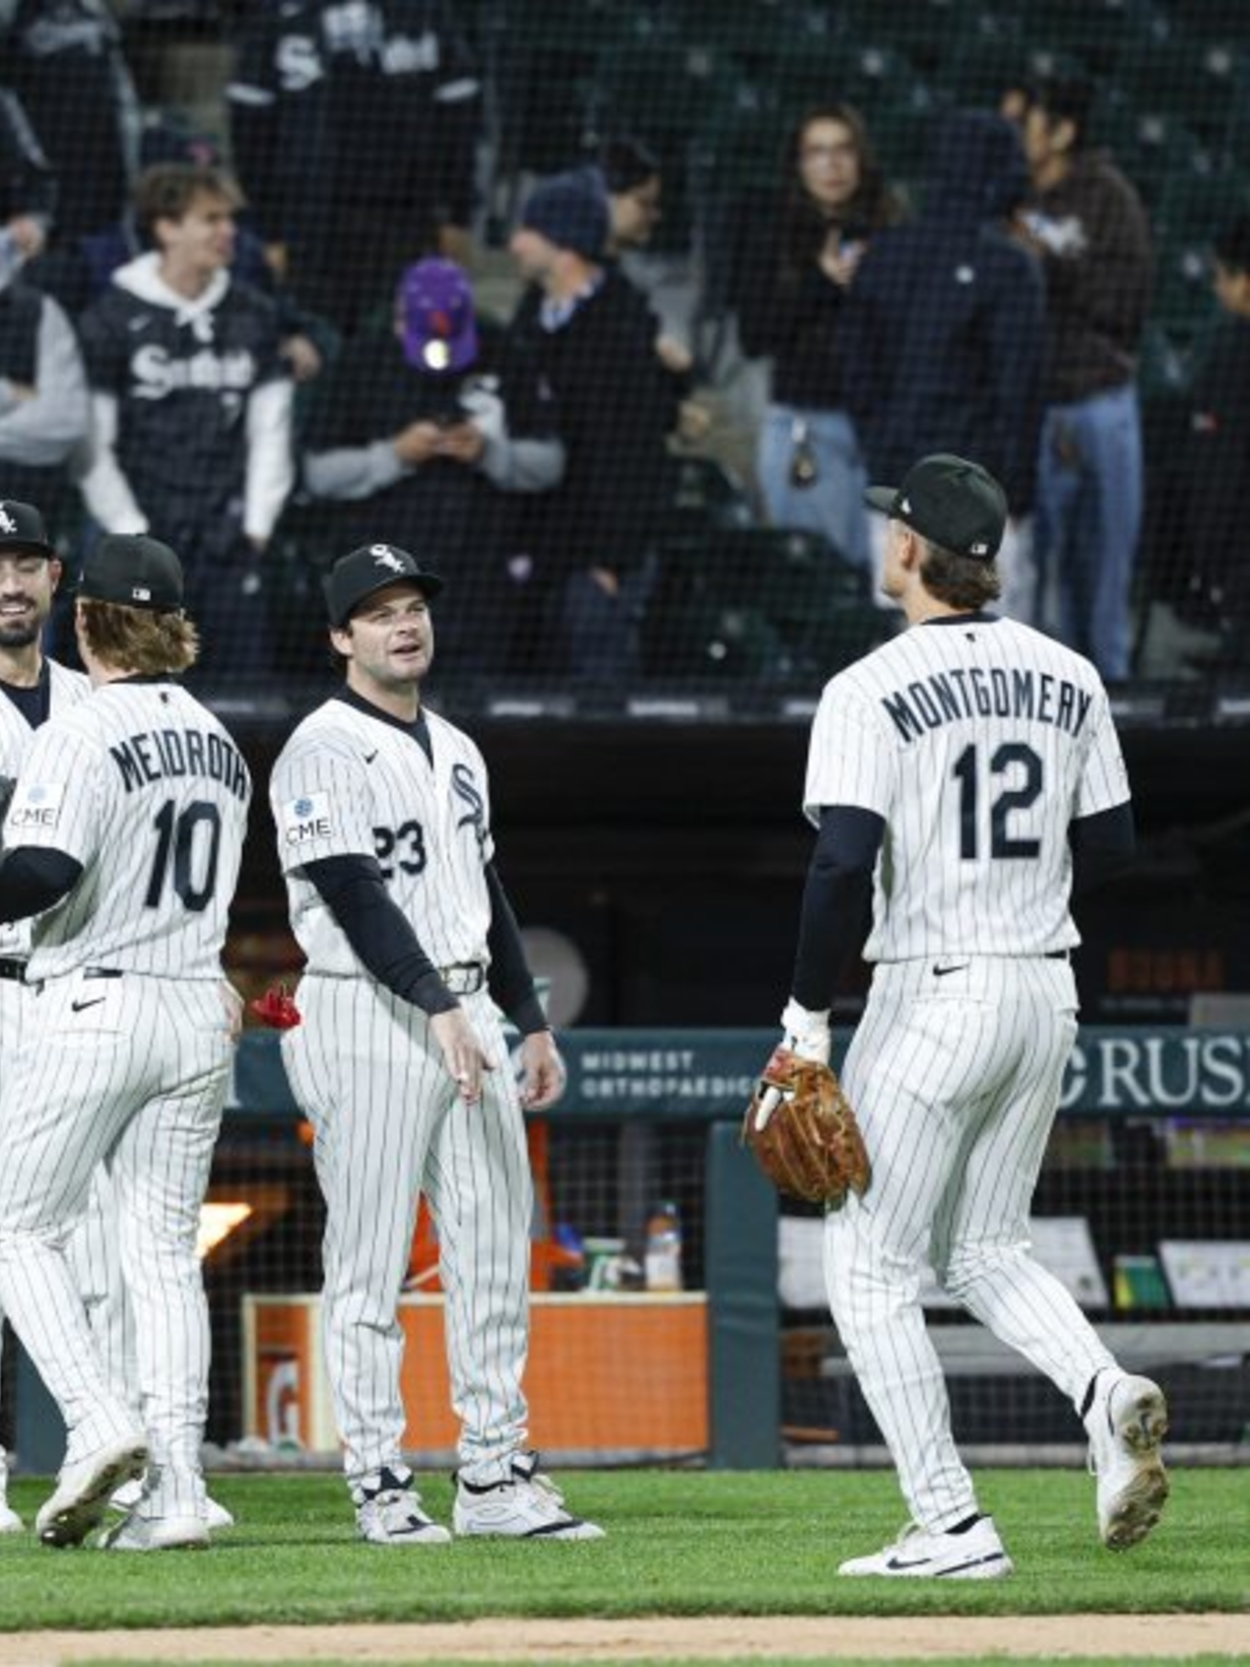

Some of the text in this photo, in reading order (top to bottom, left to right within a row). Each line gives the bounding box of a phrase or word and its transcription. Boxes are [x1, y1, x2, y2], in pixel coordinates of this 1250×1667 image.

[881, 668, 1092, 743] MONTGOMERY
[109, 729, 246, 801] MEIDROTH
[10, 808, 55, 827] CME
[285, 818, 331, 846] CME
[953, 742, 1043, 859] 12
[145, 799, 222, 912] 10
[372, 819, 426, 879] 23
[581, 1077, 751, 1097] ORTHOPAEDIC
[582, 1052, 693, 1071] MIDWEST
[1100, 1037, 1250, 1106] RUS
